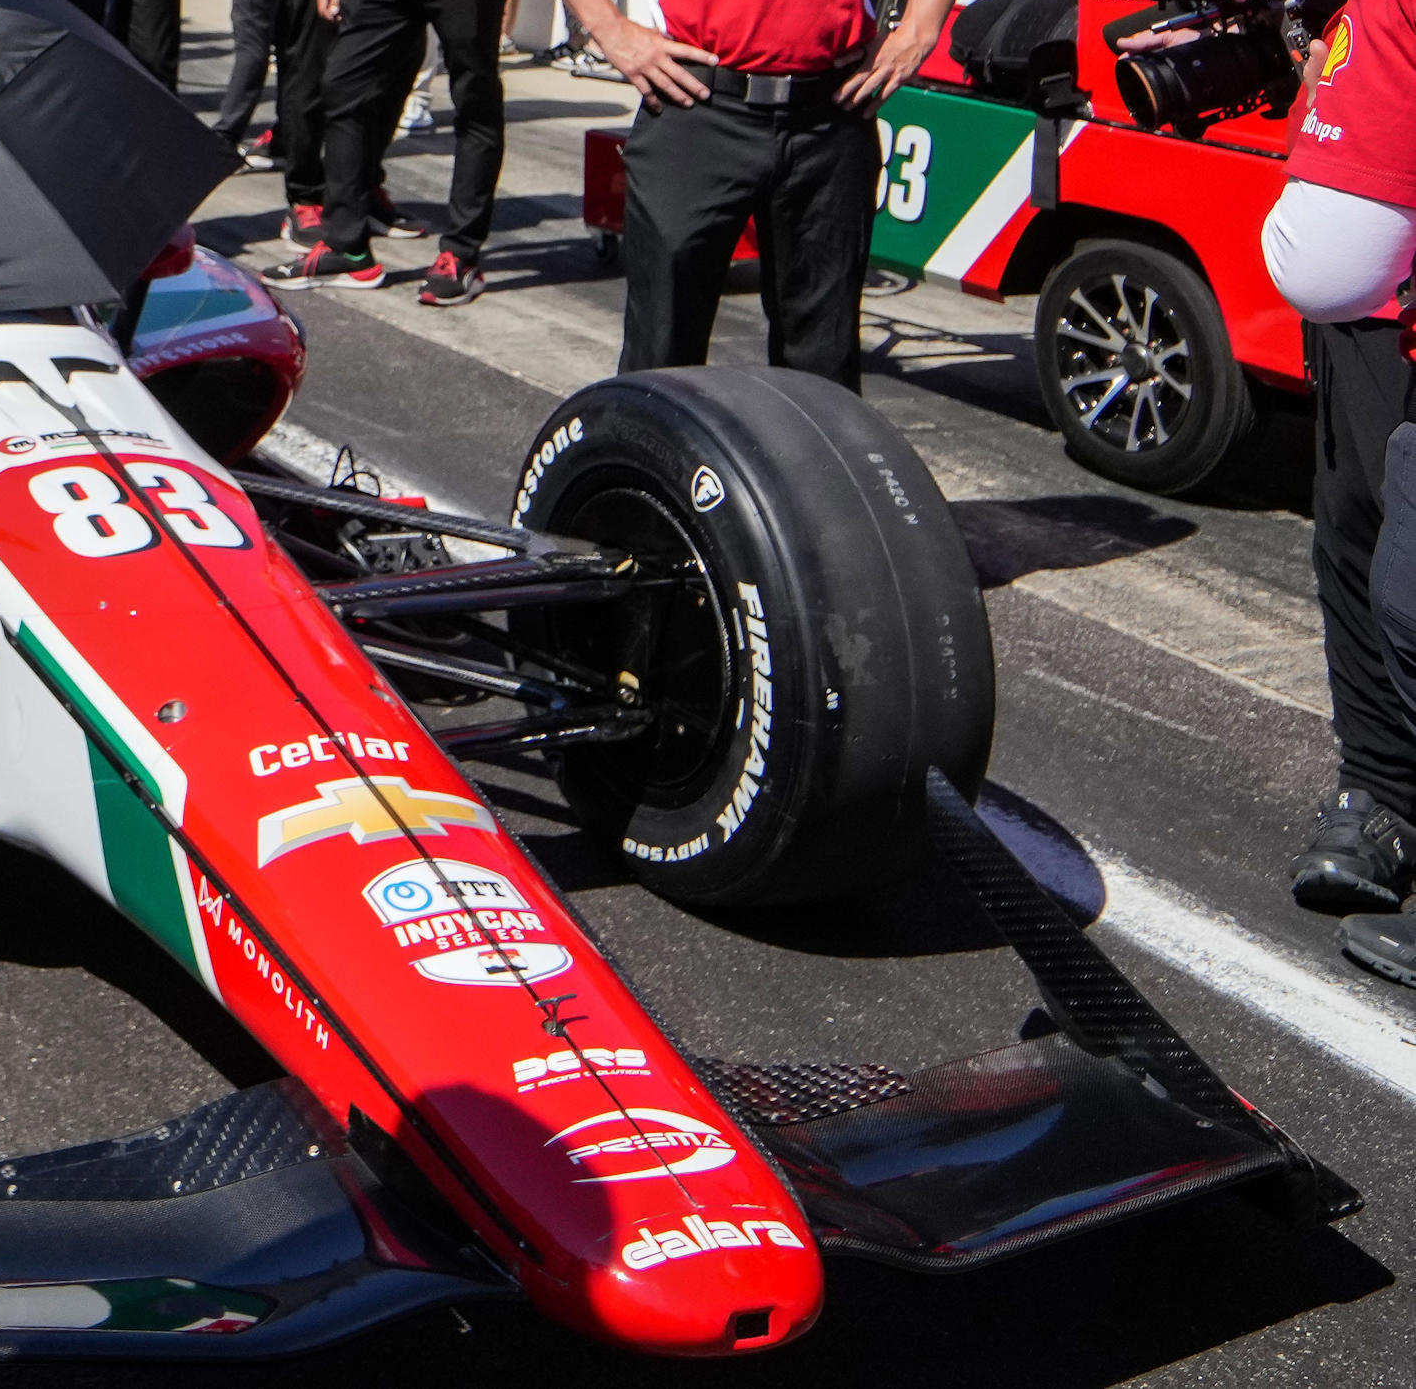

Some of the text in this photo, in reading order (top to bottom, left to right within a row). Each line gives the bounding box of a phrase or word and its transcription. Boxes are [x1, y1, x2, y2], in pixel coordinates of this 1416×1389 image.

[1314, 121, 1343, 142] ups
[28, 462, 253, 559] 83
[715, 581, 773, 844] FIREHAWK
[248, 731, 411, 778] Cetilar
[435, 879, 507, 898] NTT
[393, 909, 546, 948] INDYCAR
[436, 928, 526, 950] SERES
[227, 917, 330, 1051] MONOLITH
[565, 1131, 732, 1166] PREMA
[621, 1213, 806, 1271] dallara
